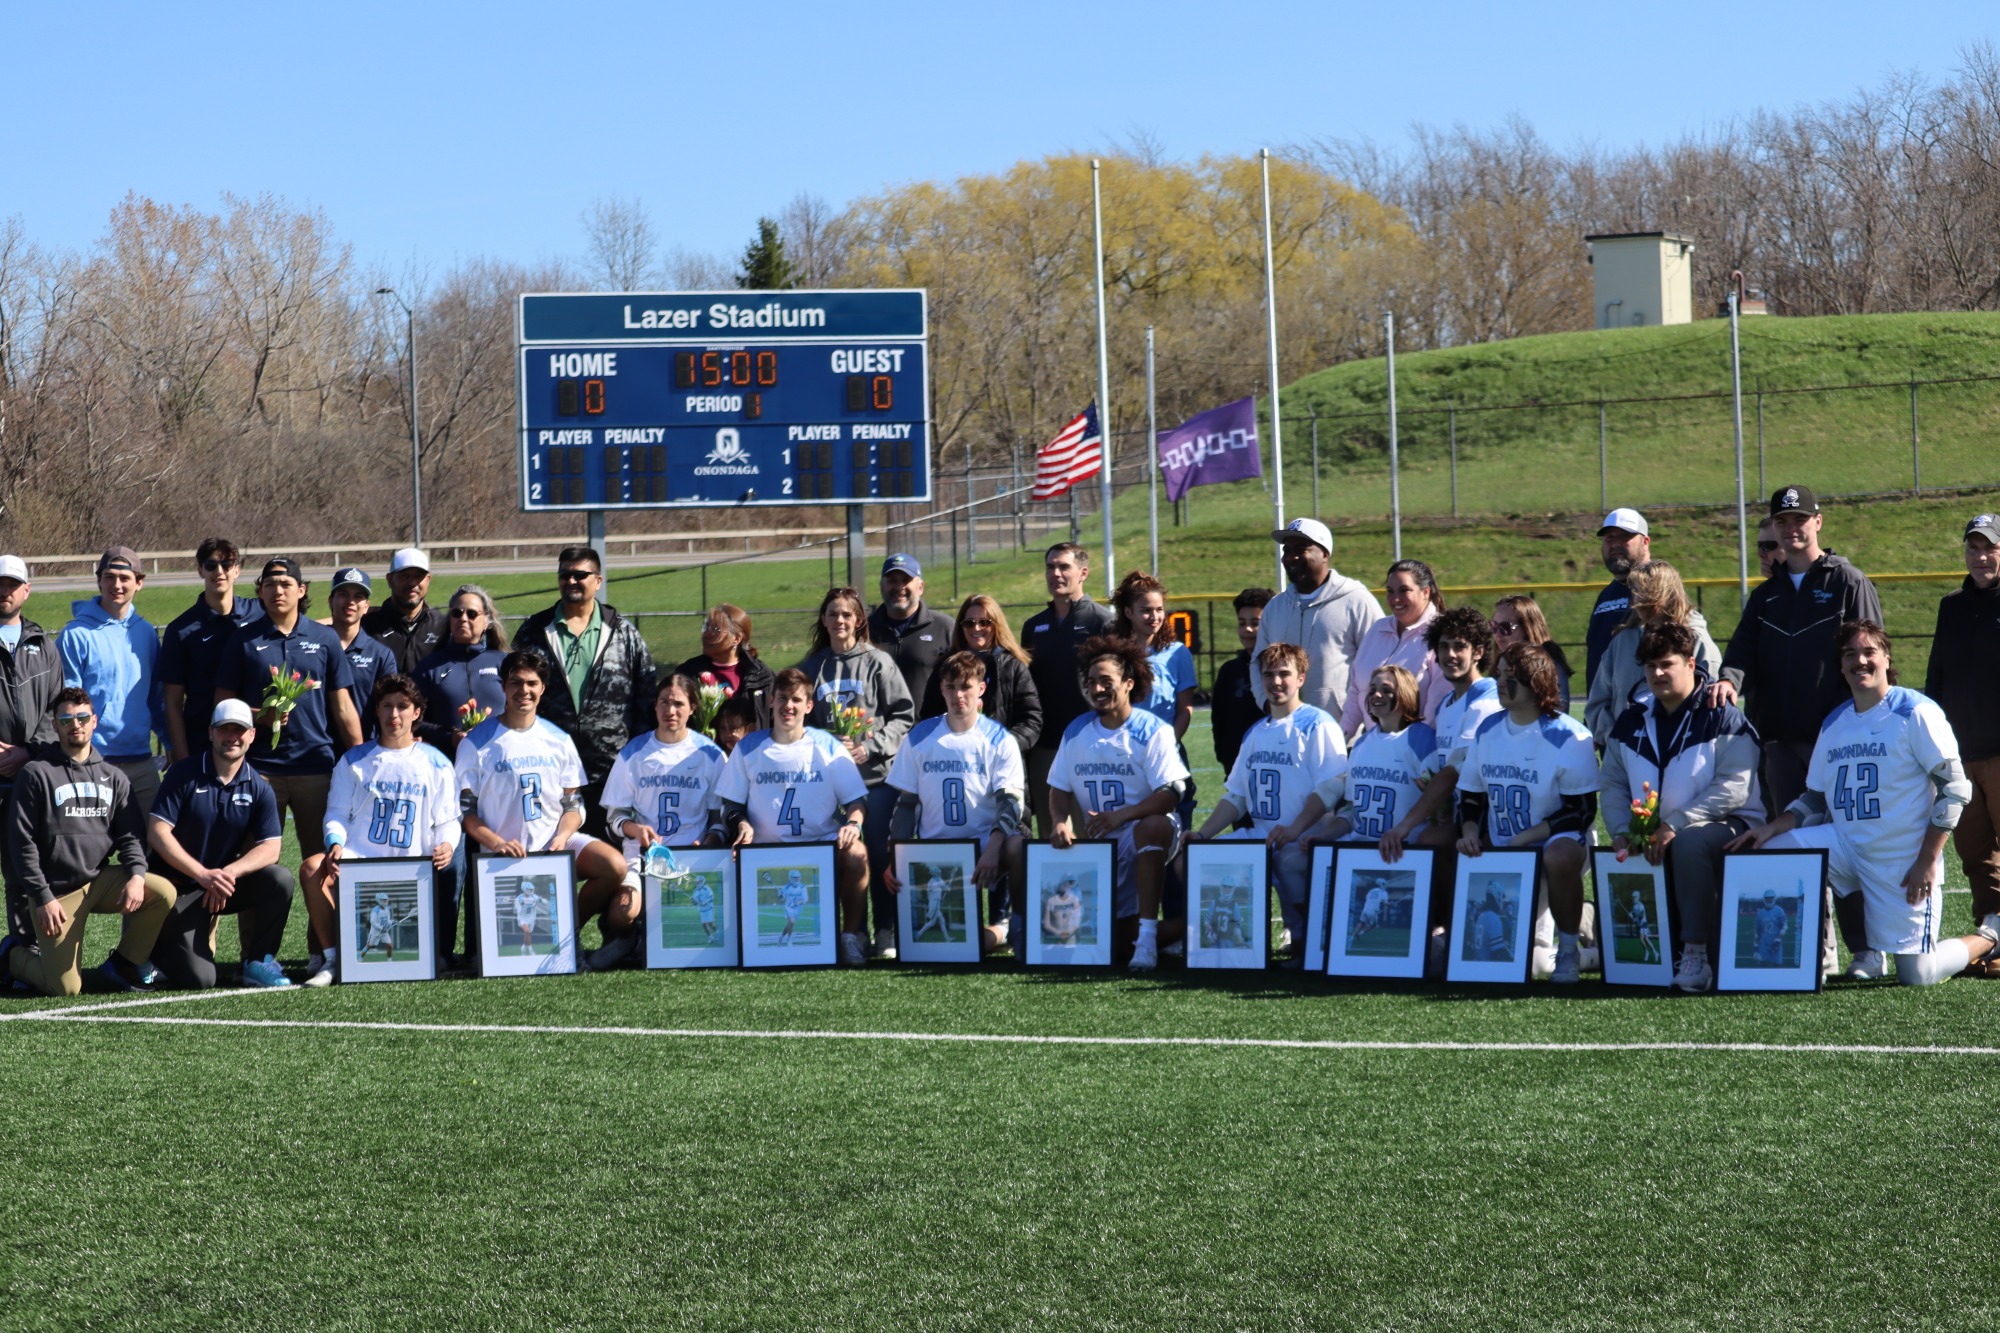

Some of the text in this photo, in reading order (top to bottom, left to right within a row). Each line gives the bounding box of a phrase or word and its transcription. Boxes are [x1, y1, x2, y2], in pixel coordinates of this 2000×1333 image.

[624, 303, 826, 329] Lazer Stadium
[550, 353, 617, 377] HOME
[831, 349, 905, 373] GUEST
[585, 380, 605, 414] 0
[873, 376, 893, 409] 0
[686, 396, 742, 413] PERIOD
[539, 428, 665, 446] PLAYER PENALTY
[788, 424, 911, 441] PLAYER PENALTY
[531, 452, 541, 470] 1
[782, 448, 791, 465] 1
[694, 465, 760, 476] ONONDAGA
[531, 482, 543, 500] 2
[782, 477, 793, 494] 2
[1827, 742, 1888, 764] ONONDAGA
[922, 760, 987, 776] ONONDAGA
[1074, 763, 1135, 777] ONONDAGA
[1350, 766, 1410, 785] ONONDAGA
[1481, 764, 1539, 785] ONONDAGA
[639, 774, 700, 789] ONONDAGA
[1833, 762, 1881, 822] 42
[519, 772, 542, 823] 2
[942, 777, 968, 827] 8
[1083, 780, 1126, 813] 12
[1249, 768, 1282, 821] 13
[64, 806, 108, 818] LACROSSE
[656, 791, 682, 837] 6
[776, 787, 805, 837] 4
[1354, 784, 1397, 839] 23
[1487, 783, 1532, 837] 28
[367, 797, 417, 850] 83
